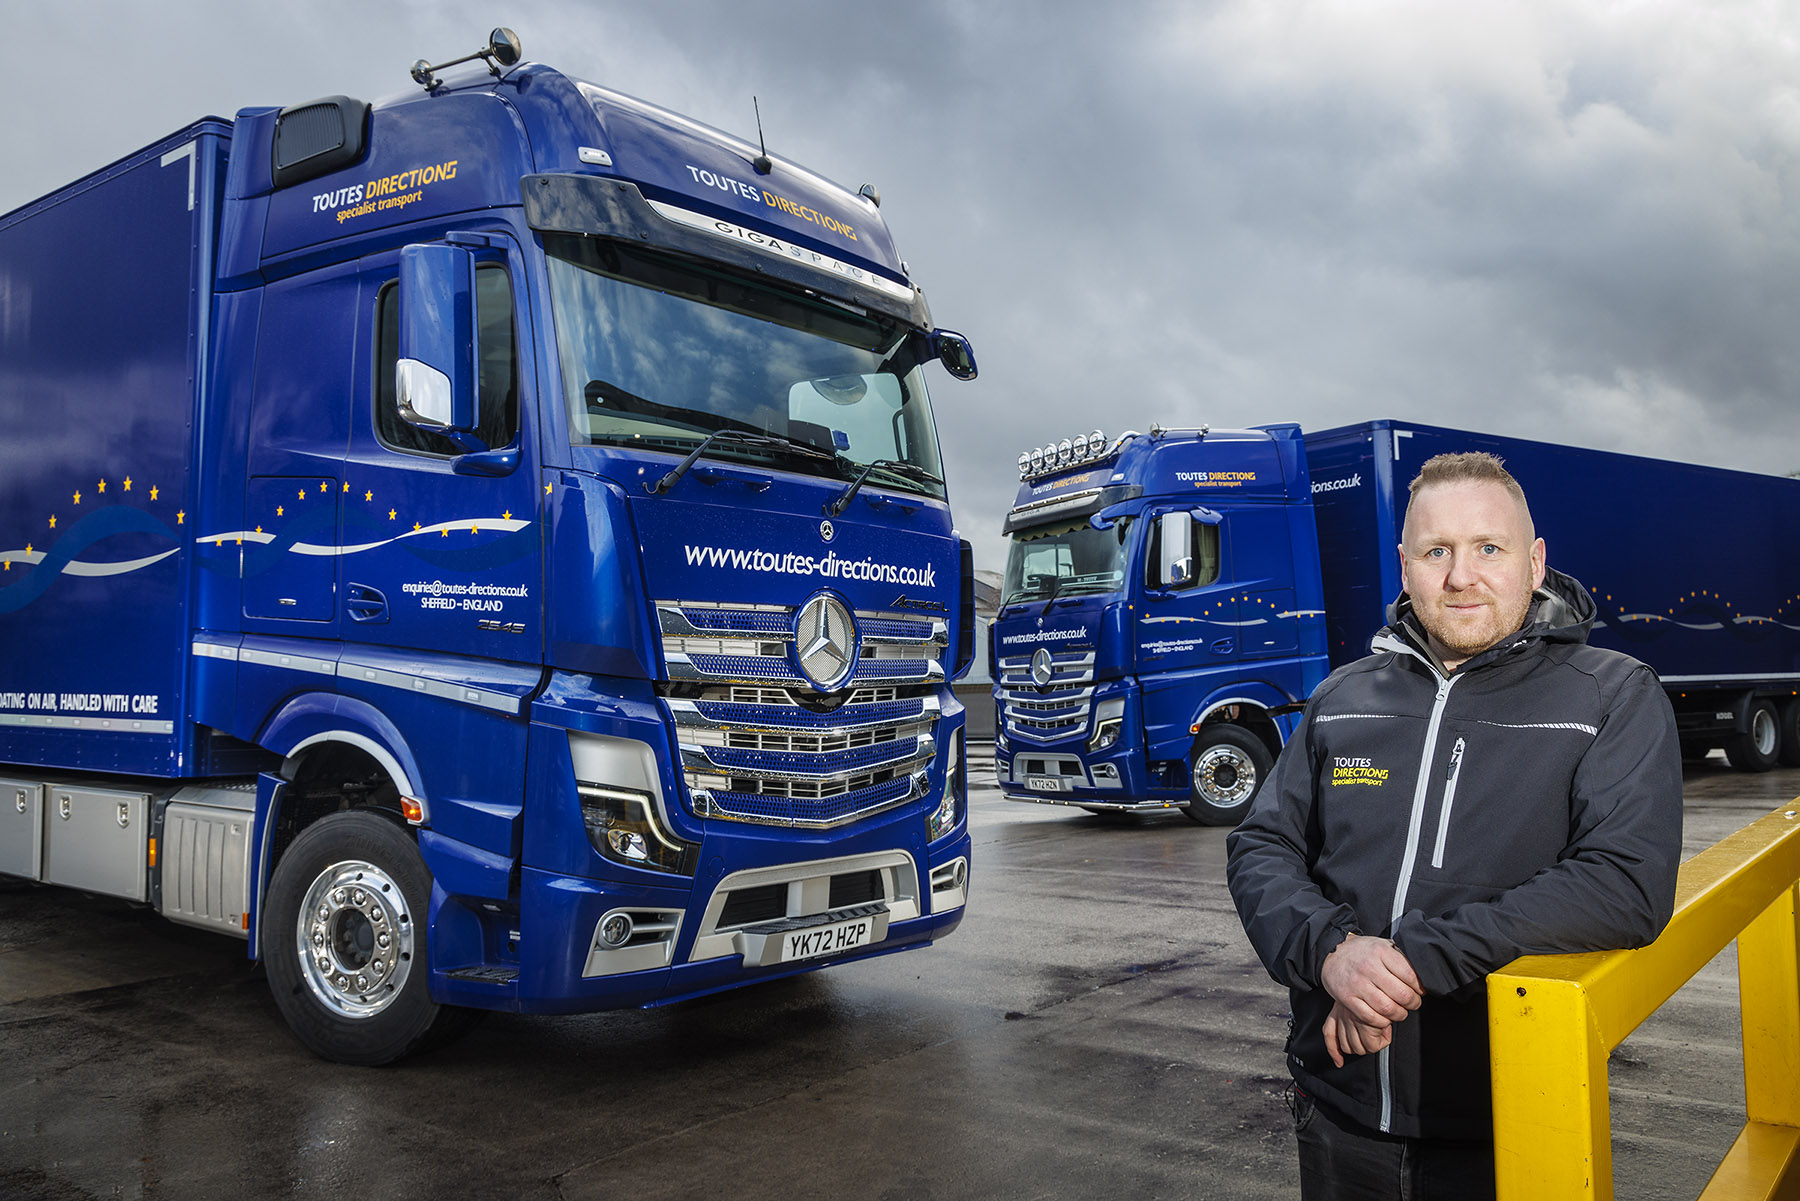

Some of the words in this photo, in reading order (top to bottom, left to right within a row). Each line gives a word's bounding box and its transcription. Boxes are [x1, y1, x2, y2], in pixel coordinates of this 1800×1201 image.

[312, 184, 364, 213] TOUTES
[365, 160, 458, 199] DIRECTIONS
[336, 201, 377, 224] specialist
[377, 190, 423, 209] transport
[686, 164, 761, 202] TOUTES
[762, 190, 858, 241] DIRECTIONS
[1175, 471, 1208, 481] TOUTES
[1208, 471, 1256, 481] DIRECTIONS
[1310, 473, 1362, 494] ions.co.uk
[1032, 483, 1054, 496] TOUTES
[684, 544, 936, 588] www.toutes-directions.co.uk
[402, 580, 529, 598] enquiries@toutes-directions.co.uk
[420, 597, 456, 610] SHEFFIELD
[463, 599, 504, 612] ENGLAND
[476, 619, 526, 634] 2545
[28, 692, 41, 709] ON
[41, 693, 58, 712] AIR,
[60, 693, 102, 712] HANDLED
[103, 694, 130, 712] WITH
[131, 695, 159, 713] CARE
[1333, 757, 1372, 768] TOUTES
[1333, 767, 1389, 780] DIRECTIONS
[791, 929, 833, 957] YK72
[835, 922, 866, 948] HZP
